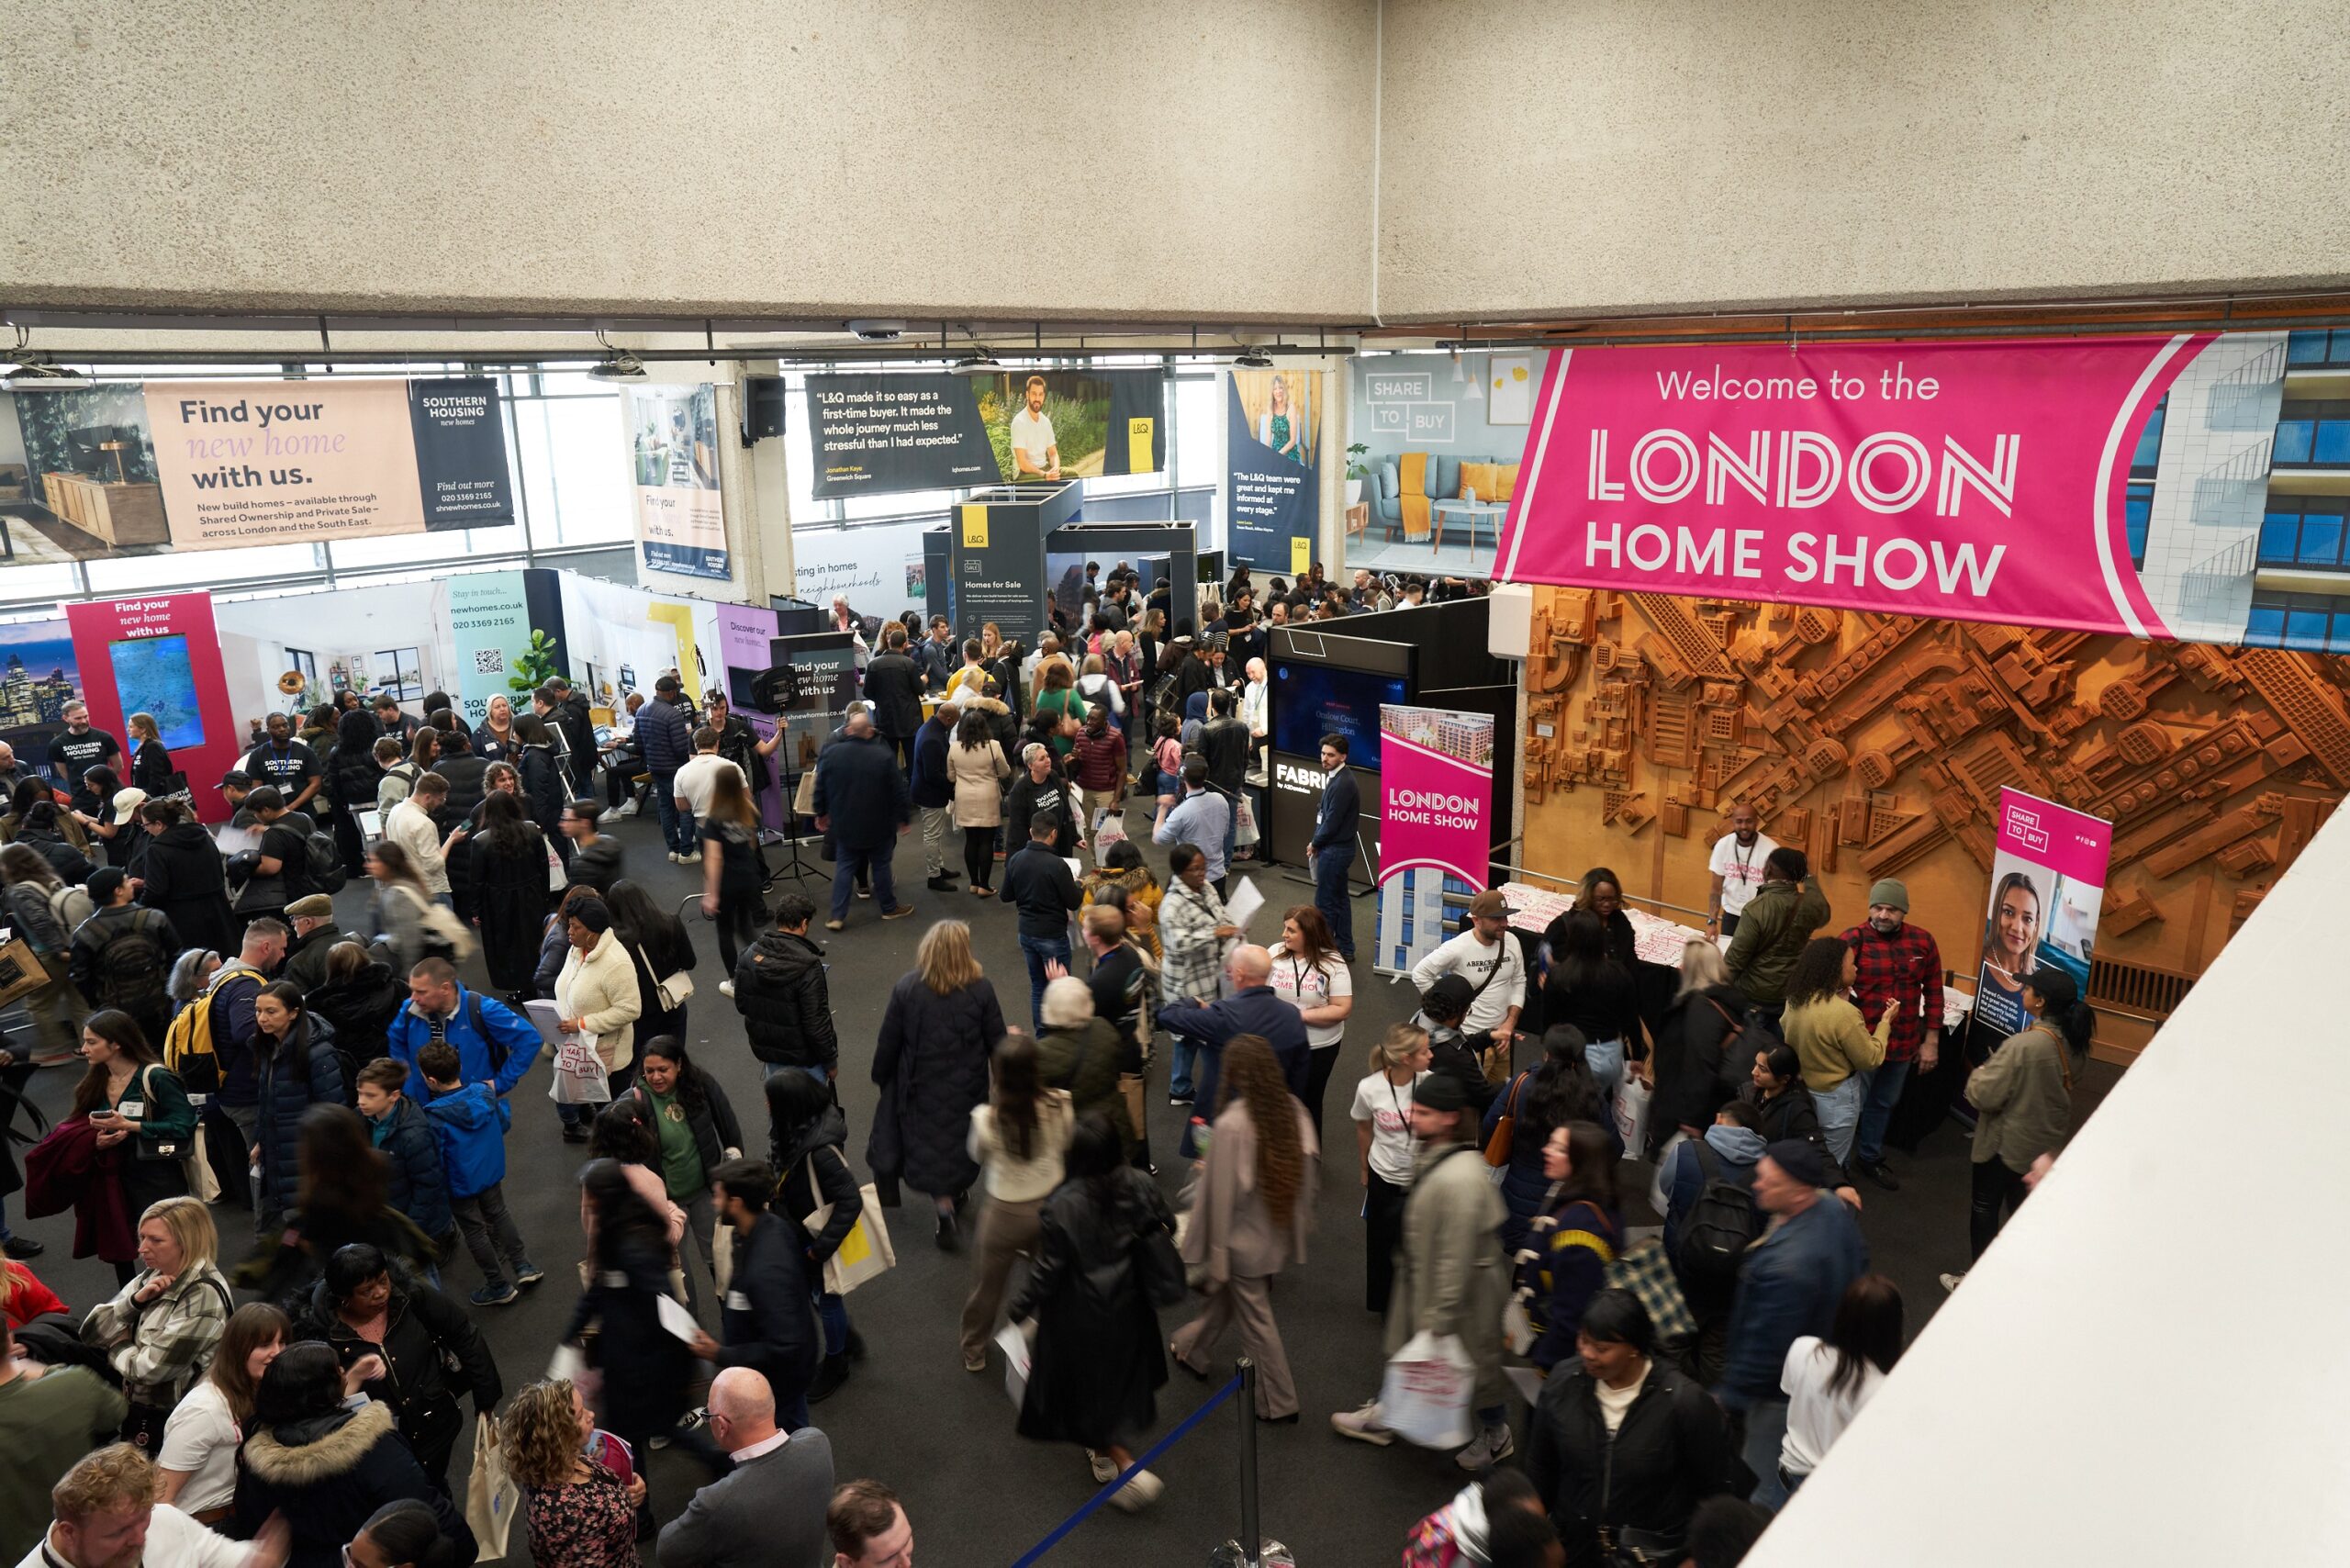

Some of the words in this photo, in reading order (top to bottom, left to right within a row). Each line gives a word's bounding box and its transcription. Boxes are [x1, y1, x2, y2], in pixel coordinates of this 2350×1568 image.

[1657, 364, 1818, 400] Welcome
[1830, 370, 1864, 399] to
[1880, 361, 1940, 399] the
[1374, 382, 1422, 395] SHARE
[423, 397, 487, 407] SOUTHERN
[847, 391, 873, 402] made
[876, 391, 882, 401] it
[885, 393, 895, 401] so
[898, 391, 918, 403] easy
[921, 391, 931, 400] as
[180, 400, 249, 423] Find
[255, 403, 323, 428] your
[430, 407, 484, 418] HOUSING
[822, 408, 867, 420] first-time
[869, 407, 898, 419] buyer.
[901, 406, 907, 416] It
[910, 406, 934, 415] made
[937, 405, 952, 414] the
[1381, 410, 1399, 423] TO
[1416, 415, 1445, 428] BUY
[823, 424, 854, 435] whole
[856, 423, 890, 436] journey
[893, 421, 918, 431] much
[922, 420, 938, 430] less
[1134, 424, 1148, 433] L&Q
[186, 436, 253, 459] new
[264, 427, 345, 456] home
[824, 439, 865, 451] stressful
[867, 438, 888, 448] than
[891, 438, 894, 447] I
[897, 437, 913, 447] had
[192, 465, 262, 489] with
[270, 467, 312, 485] us.
[1587, 429, 2020, 519] LONDON
[437, 482, 455, 491] Find
[1268, 485, 1282, 495] kept
[197, 503, 220, 511] New
[223, 500, 249, 510] build
[251, 498, 285, 509] homes
[295, 496, 337, 506] available
[339, 493, 376, 504] through
[646, 495, 659, 506] Find
[661, 499, 675, 509] your
[1237, 494, 1265, 503] informed
[436, 501, 500, 512] shnewhomes.co.uk
[200, 515, 237, 525] Shared
[239, 510, 294, 522] Ownership
[297, 510, 314, 519] and
[316, 507, 350, 517] Private
[202, 529, 236, 538] across
[239, 525, 276, 534] London
[279, 523, 297, 532] and
[299, 521, 315, 530] the
[318, 520, 346, 529] South
[348, 518, 372, 526] East.
[649, 525, 663, 535] with
[1585, 521, 1764, 578] HOME
[1785, 532, 2007, 597] SHOW
[818, 564, 825, 573] in
[828, 562, 857, 572] homes
[800, 572, 882, 602] neighbourhoods
[453, 590, 469, 599] Stay
[115, 601, 141, 612] Find
[143, 600, 170, 611] your
[451, 602, 523, 614] newhomes.co.uk
[143, 613, 171, 622] home
[494, 618, 514, 626] 2165
[127, 627, 152, 637] with
[731, 622, 755, 633] Discover
[814, 661, 839, 673] your
[798, 676, 811, 684] ew
[812, 673, 838, 683] home
[822, 686, 835, 694] us
[788, 710, 845, 721] shnewhomes.co.uk
[1316, 711, 1339, 721] Onslow
[1340, 715, 1360, 725] Court,
[1322, 722, 1355, 734] Hillingdon
[63, 742, 102, 751] SOUTHERN
[66, 747, 99, 756] HOUSING
[1277, 764, 1329, 790] FABRI
[1389, 788, 1479, 814] LONDON
[1389, 809, 1430, 824] HOME
[1434, 814, 1478, 830] SHOW
[2011, 812, 2034, 825] SHARE
[2012, 825, 2022, 834] TO
[2028, 834, 2043, 845] BUY
[1983, 987, 1997, 997] Shared
[1998, 994, 2018, 1008] Ownership
